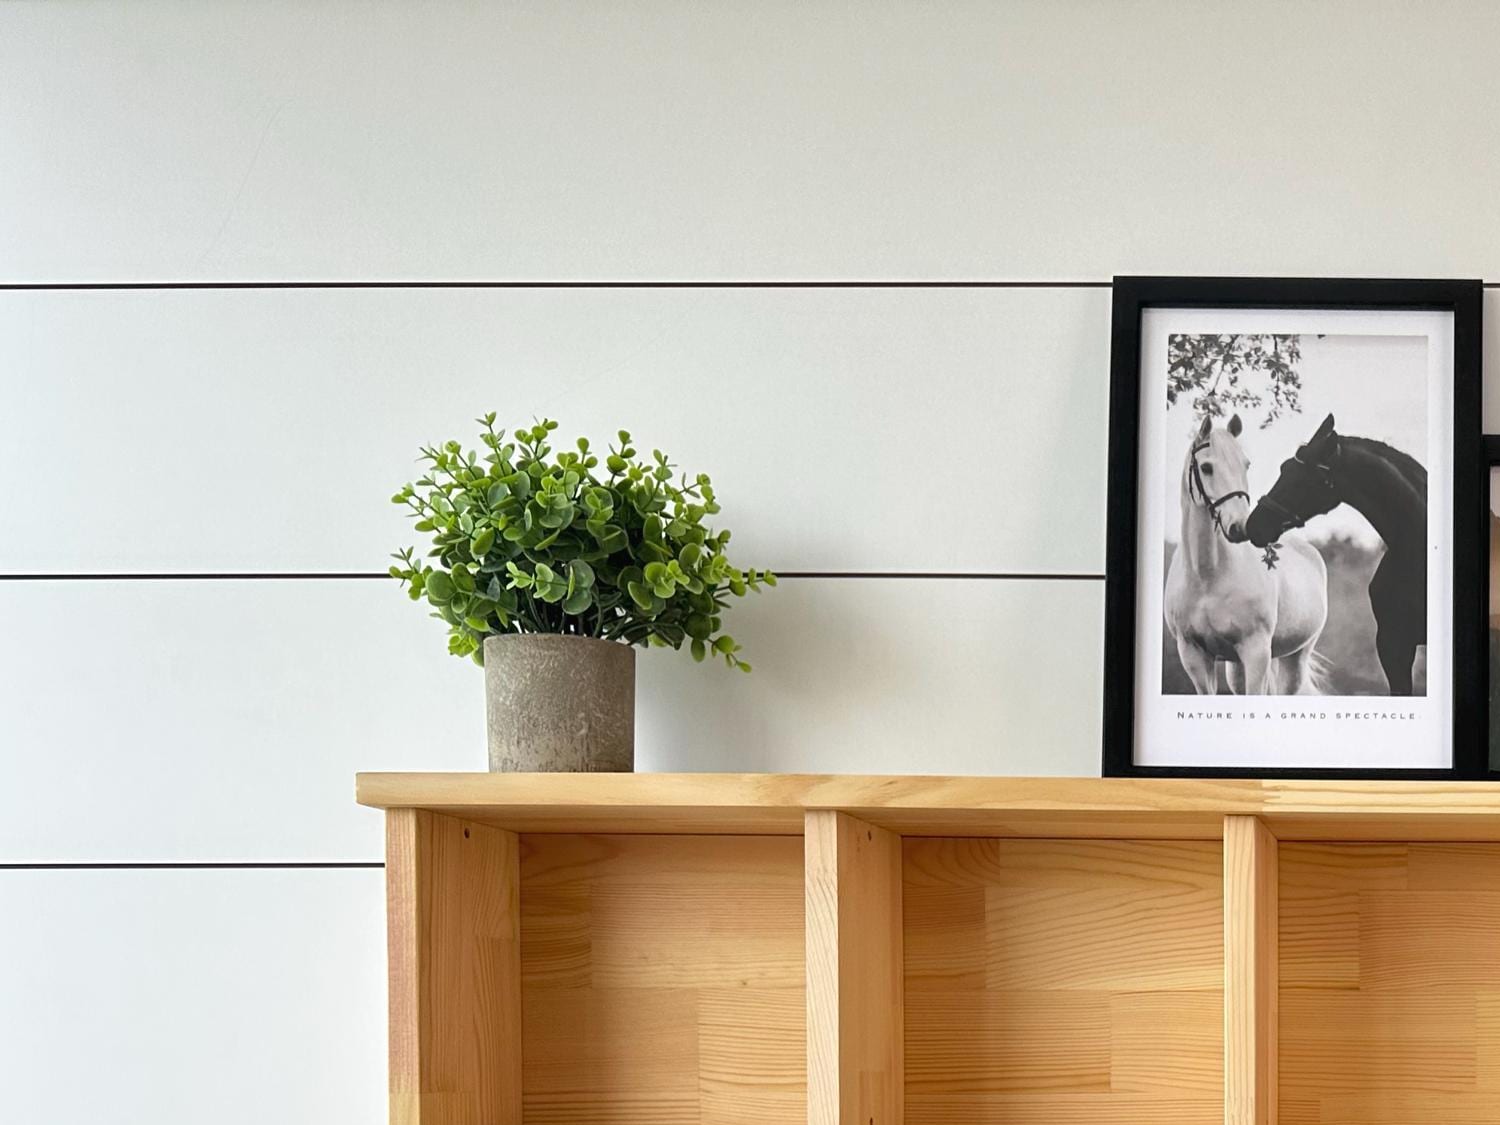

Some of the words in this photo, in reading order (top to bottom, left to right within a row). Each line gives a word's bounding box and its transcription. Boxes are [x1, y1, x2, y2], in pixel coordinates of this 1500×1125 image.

[1177, 711, 1233, 720] NATURE
[1242, 712, 1256, 720] IS
[1265, 712, 1272, 720] A
[1280, 712, 1327, 720] GRAND
[1335, 712, 1416, 720] SPECTACLE
